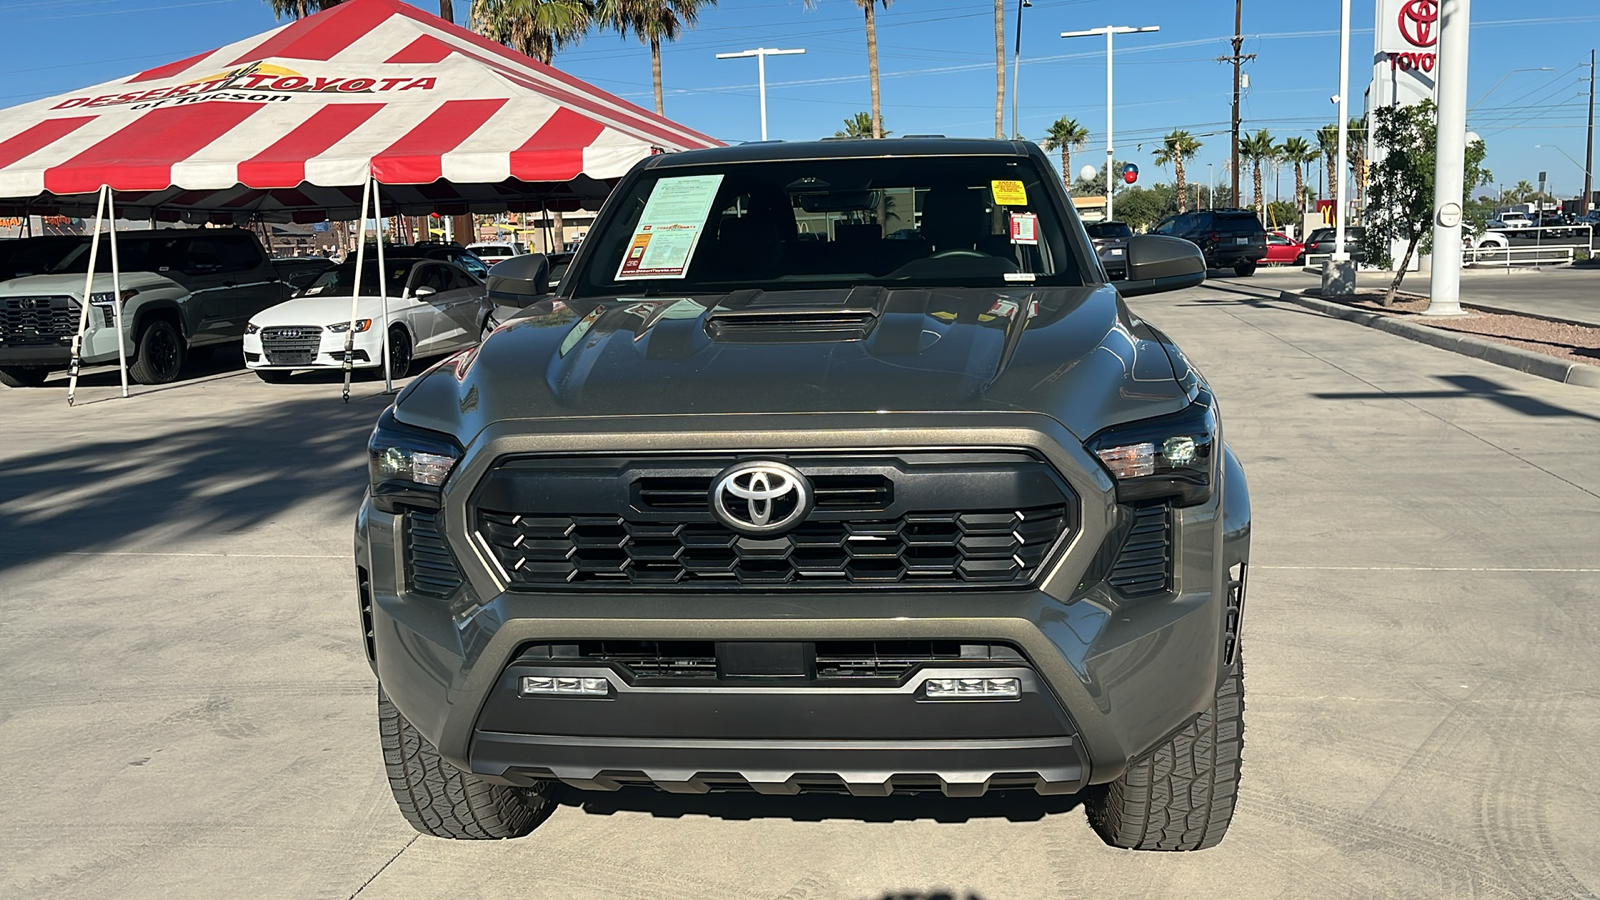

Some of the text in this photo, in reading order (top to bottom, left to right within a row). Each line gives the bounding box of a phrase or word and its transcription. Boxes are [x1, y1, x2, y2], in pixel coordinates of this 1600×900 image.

[48, 74, 437, 110] DESERT TOYOTA
[130, 93, 292, 110] of Tucson
